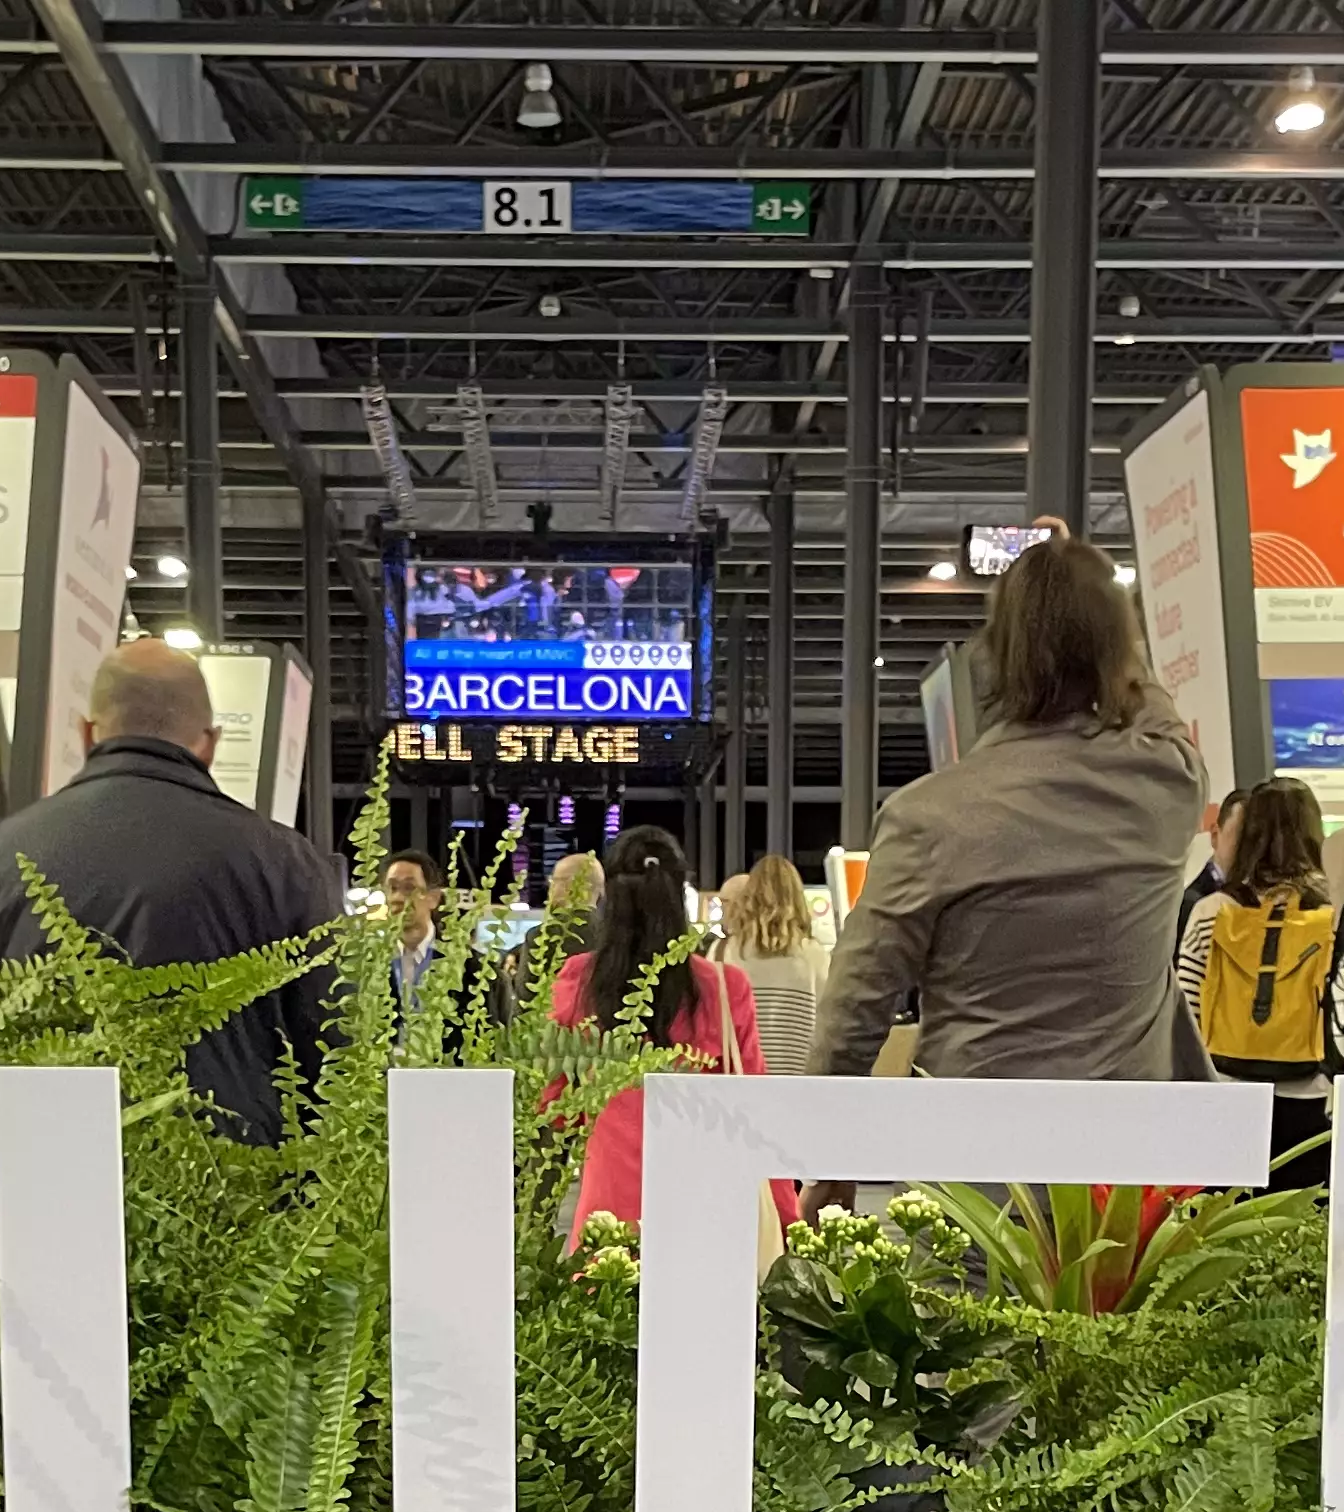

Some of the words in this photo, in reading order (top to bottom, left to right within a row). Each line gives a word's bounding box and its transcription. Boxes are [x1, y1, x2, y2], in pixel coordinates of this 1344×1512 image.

[493, 187, 562, 227] 8.1
[406, 675, 687, 711] BARCELONA
[387, 723, 472, 760] ELL
[497, 725, 639, 762] STAGE
